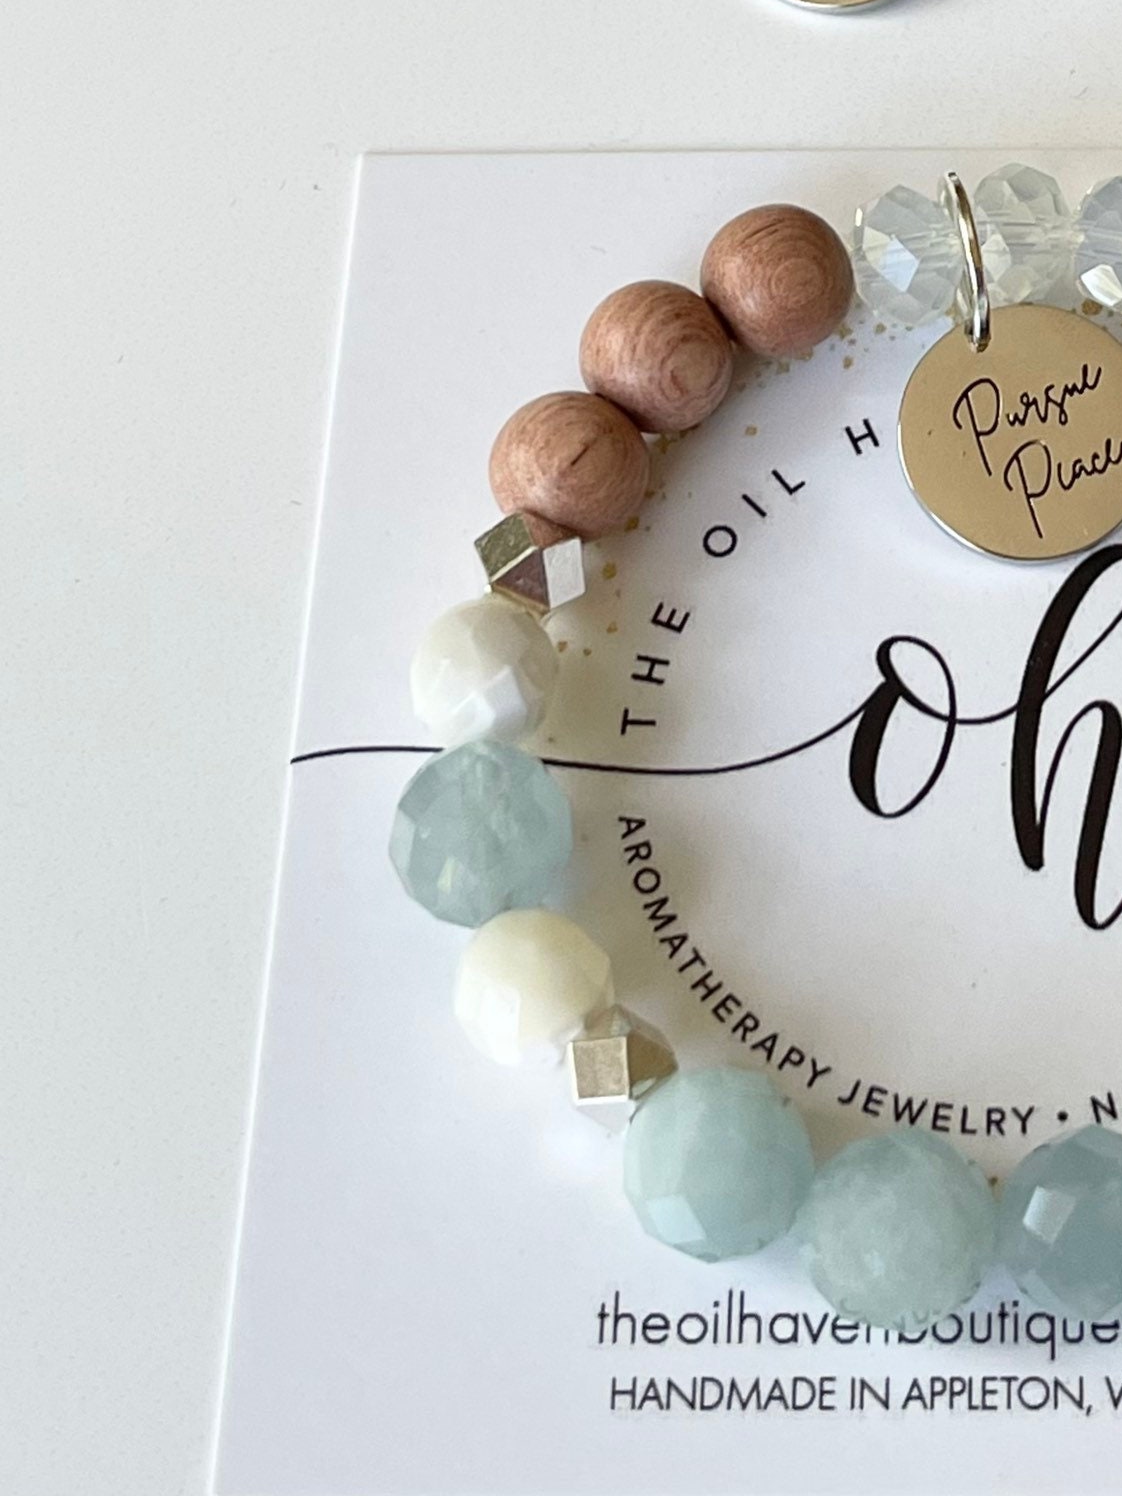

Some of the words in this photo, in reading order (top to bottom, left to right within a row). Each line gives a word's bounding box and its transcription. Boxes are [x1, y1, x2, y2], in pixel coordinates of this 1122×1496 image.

[953, 364, 1102, 477] Pursue
[620, 602, 691, 736] THE
[702, 469, 806, 558] OIL
[618, 815, 832, 1089] AROMATHERAPY
[838, 1079, 1035, 1136] JEWELRY
[610, 1375, 836, 1411] HANDMADE
[850, 1375, 890, 1411] IN
[901, 1375, 1092, 1416] APPLETON,
